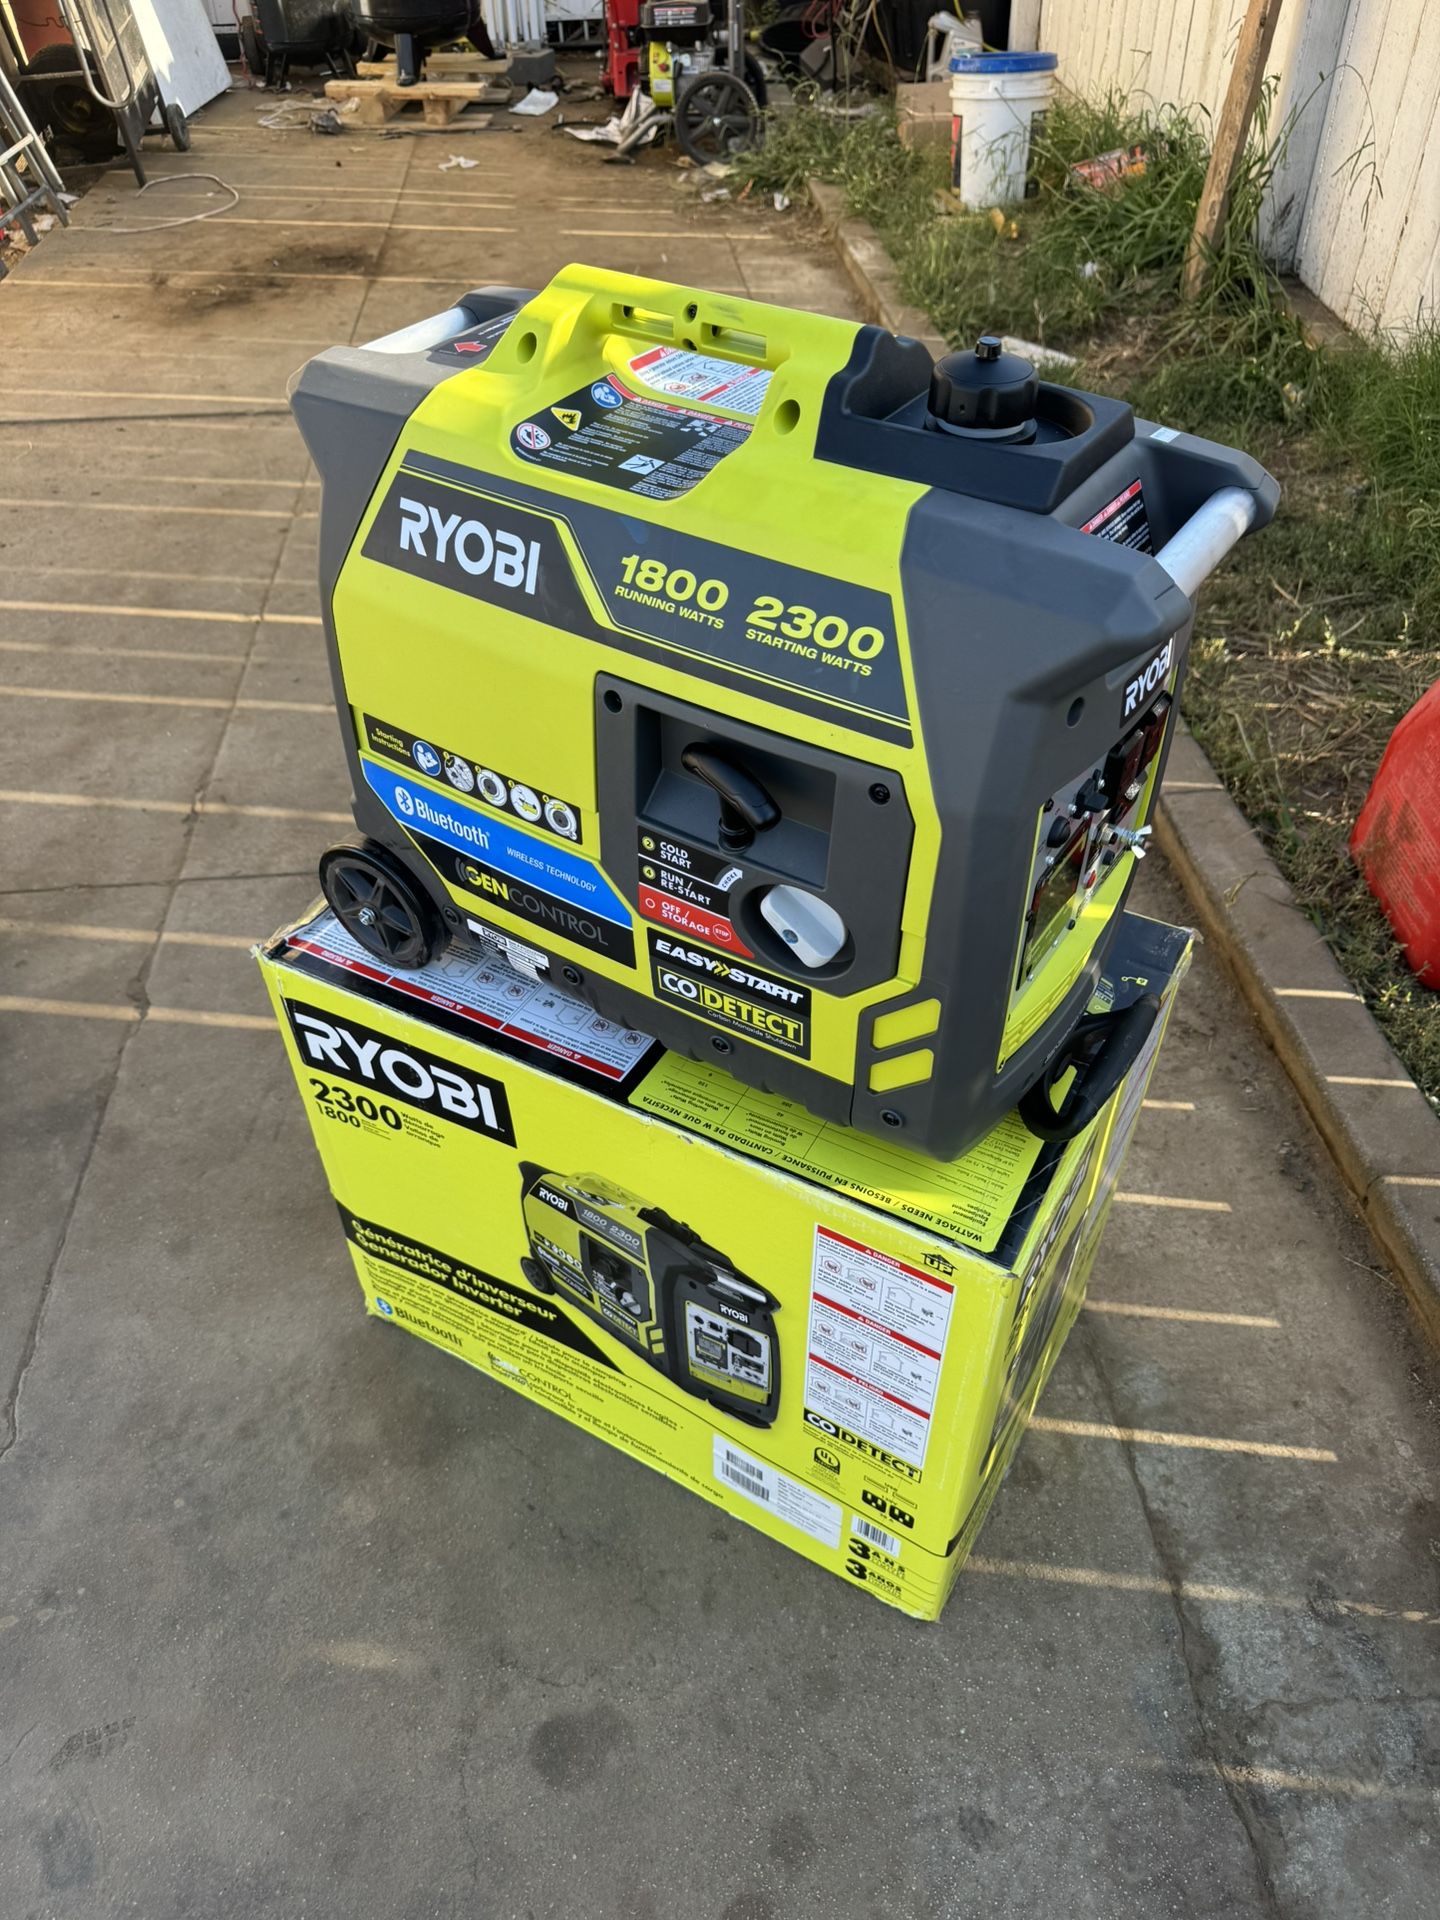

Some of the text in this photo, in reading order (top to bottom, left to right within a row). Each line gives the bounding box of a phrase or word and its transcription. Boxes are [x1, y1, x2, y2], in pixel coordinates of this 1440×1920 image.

[399, 496, 541, 596] RYOBI
[614, 554, 730, 612] 1800
[614, 585, 725, 631] RUNNING WATTS
[746, 596, 886, 661] 2300
[745, 628, 874, 677] STARTING WATTS
[1124, 637, 1174, 717] RYOBI
[371, 734, 411, 758] Instructions
[375, 728, 404, 748] Starting
[414, 798, 488, 851] Bluetooth
[660, 841, 688, 859] COLD
[660, 851, 692, 870] START
[506, 847, 598, 893] WIRELESS TECHNOLOGY
[661, 869, 685, 887] RUN
[660, 879, 711, 906] RE-START
[661, 901, 681, 915] OFF
[661, 909, 730, 938] STORAGE STOP
[655, 938, 804, 1005] EASY START
[430, 993, 455, 1008] DANGER
[662, 973, 799, 1036] CO DETECT
[707, 1009, 797, 1050] Carbon Monoxide Shutdown
[546, 1042, 572, 1056] DANGER
[293, 1011, 500, 1133] RYOBI
[308, 1078, 403, 1131] 2300
[316, 1100, 361, 1128] 1800
[643, 1095, 682, 1119] NECESITA
[681, 1112, 702, 1124] QUE
[702, 1121, 713, 1129] W
[712, 1126, 726, 1135] DE
[726, 1132, 773, 1154] CANTIDAD
[780, 1154, 833, 1180] PUISSANCE
[834, 1176, 848, 1186] EN
[848, 1182, 893, 1203] BESOINS
[538, 1187, 568, 1212] RYOBI
[900, 1204, 934, 1220] NEEDS
[582, 1208, 608, 1226] 1800
[609, 1225, 640, 1247] 2300
[933, 1217, 985, 1242] WATTAGE
[950, 1210, 987, 1226] Equipment
[351, 1219, 453, 1272] Génératrice
[456, 1269, 558, 1322] d'inverseur
[873, 1249, 901, 1268] DANGER
[355, 1232, 450, 1284] Generador
[452, 1276, 523, 1319] Inverter
[719, 1303, 750, 1324] RYOBI
[396, 1306, 464, 1347] Bluetooth
[864, 1320, 892, 1335] DANGER
[807, 1412, 837, 1434] CO
[841, 1430, 919, 1478] DETECT
[848, 1537, 871, 1560] 3
[845, 1558, 868, 1580] 3
